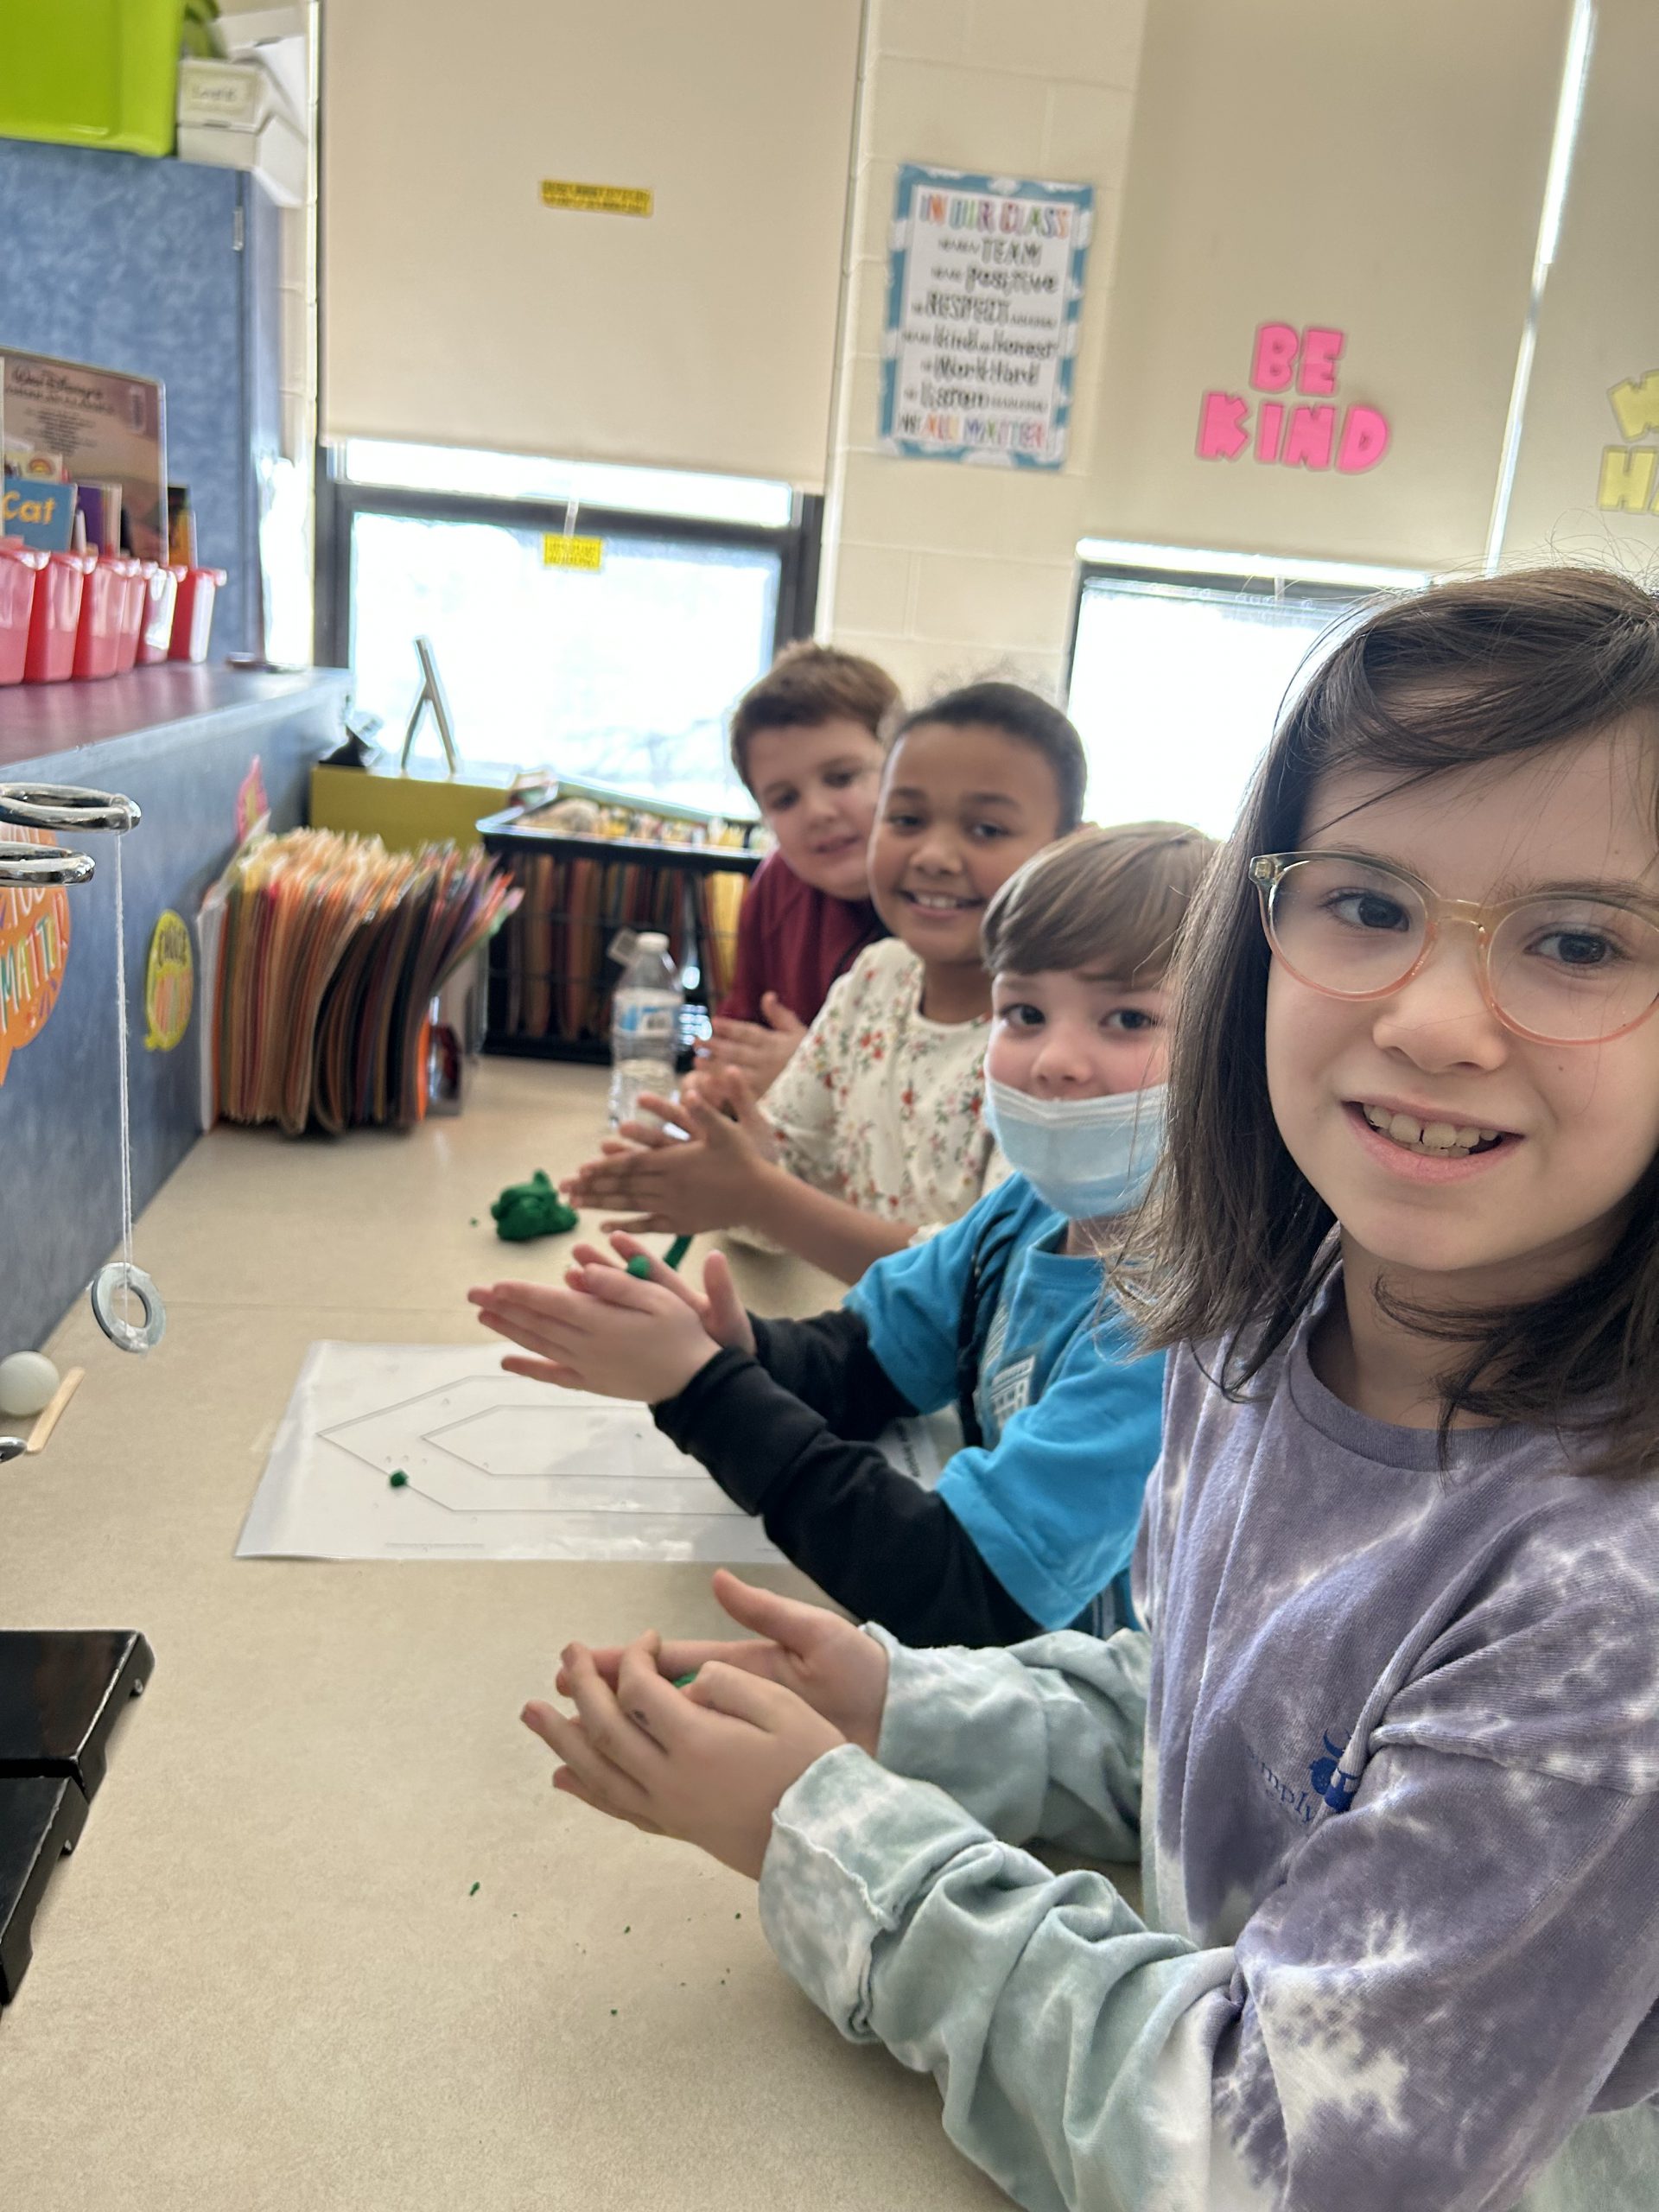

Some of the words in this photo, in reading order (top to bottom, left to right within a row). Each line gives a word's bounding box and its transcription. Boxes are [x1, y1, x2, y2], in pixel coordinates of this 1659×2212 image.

[1252, 324, 1344, 396] BE
[1198, 391, 1389, 473] KIND
[3, 491, 55, 524] Cat
[1247, 1744, 1316, 1825] mply
